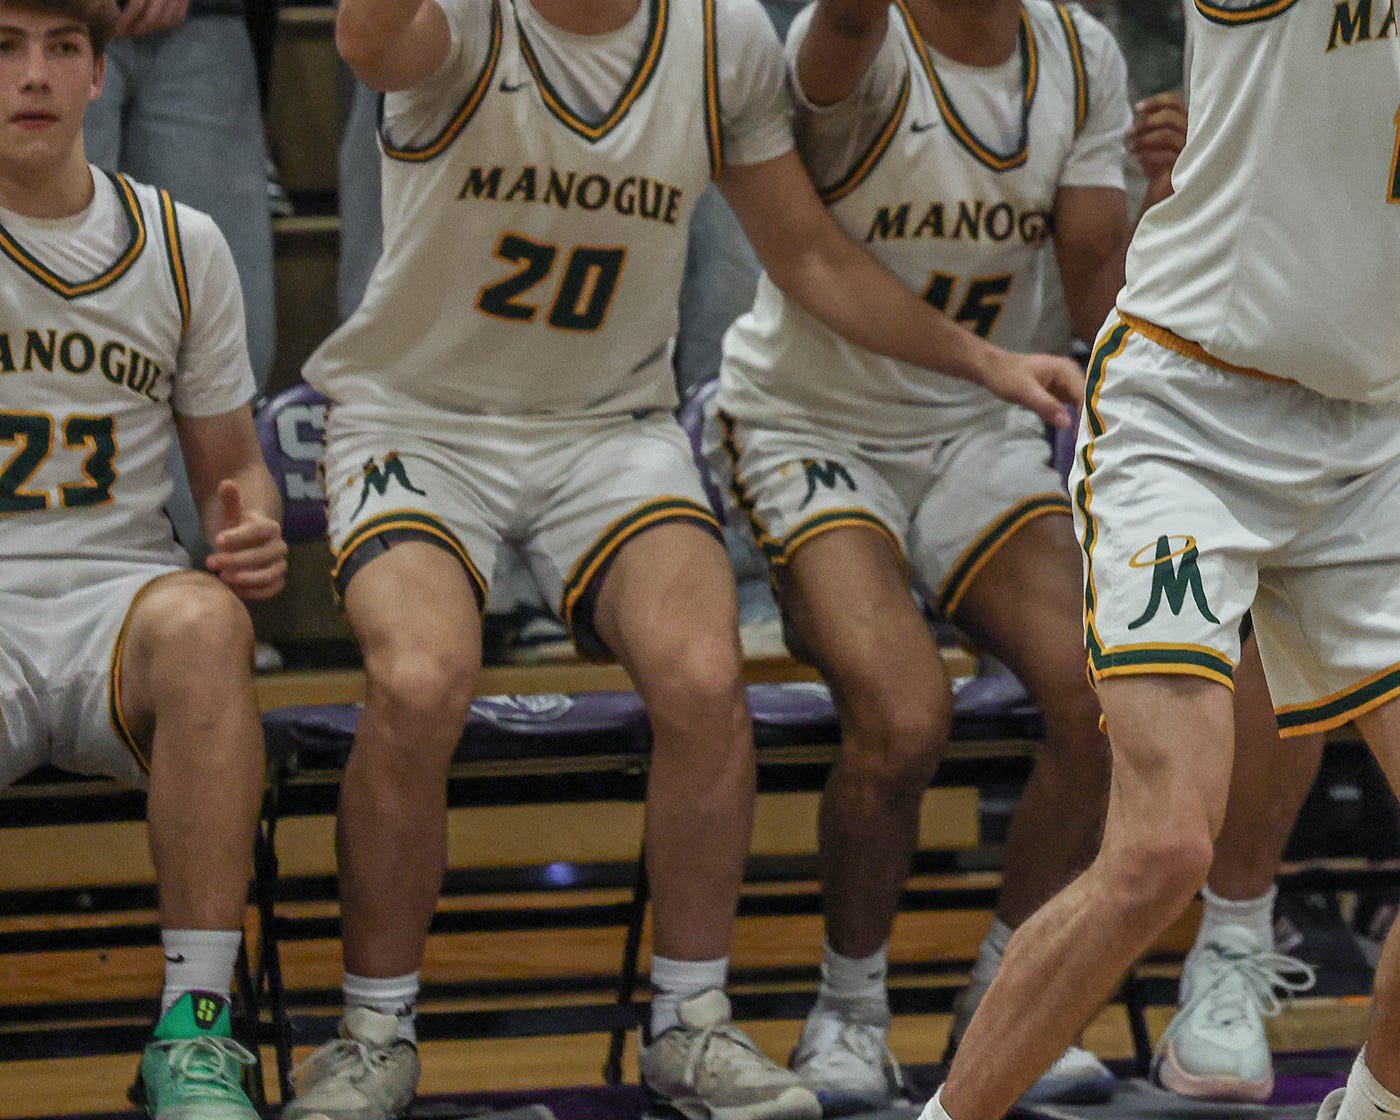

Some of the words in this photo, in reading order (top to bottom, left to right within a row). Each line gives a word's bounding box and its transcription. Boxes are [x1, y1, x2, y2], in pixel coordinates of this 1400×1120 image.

[455, 164, 682, 226] MANOGUE
[864, 197, 1055, 245] MANOG
[473, 230, 627, 334] 20
[0, 326, 162, 404] ANOGUE
[0, 407, 119, 518] 23
